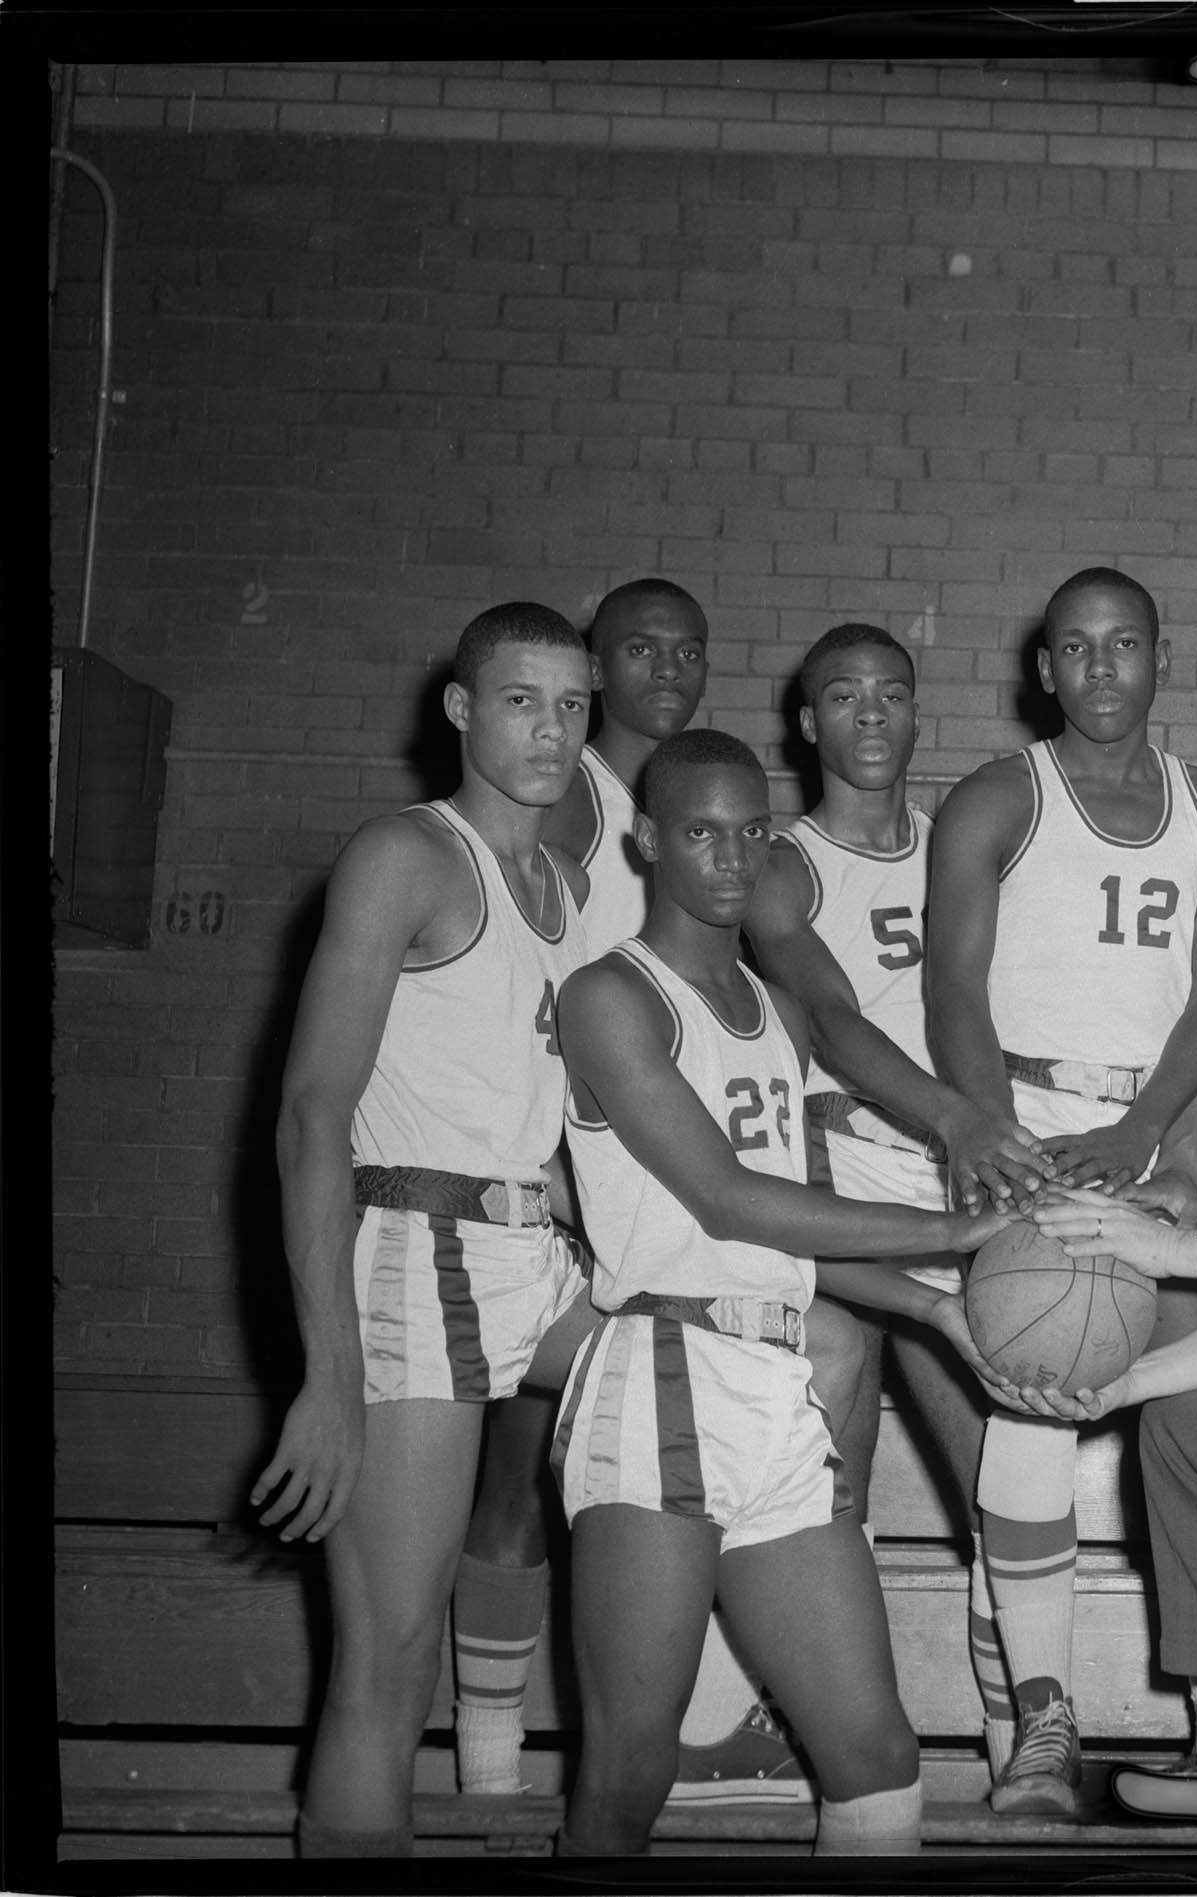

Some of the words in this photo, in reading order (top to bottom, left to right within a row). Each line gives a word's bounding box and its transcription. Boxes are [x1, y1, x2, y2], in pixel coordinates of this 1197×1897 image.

[241, 582, 268, 625] 2
[908, 605, 936, 646] 4
[166, 892, 225, 934] 60
[1099, 875, 1180, 949] 12
[870, 906, 922, 971] 5
